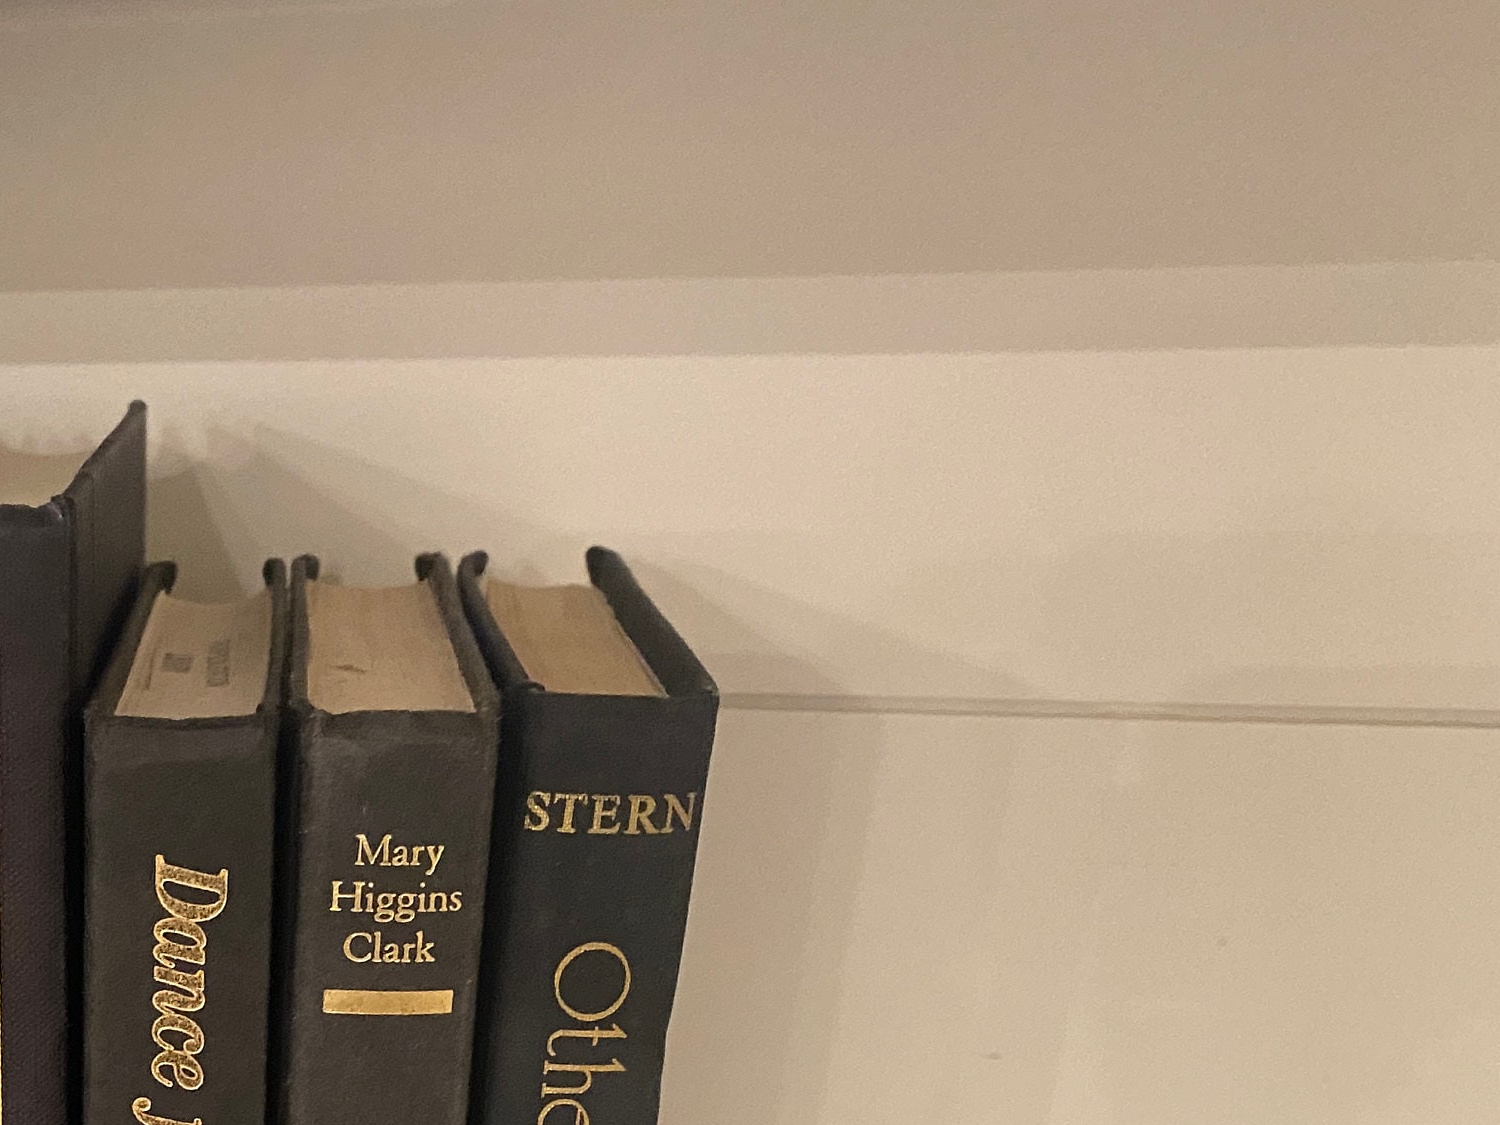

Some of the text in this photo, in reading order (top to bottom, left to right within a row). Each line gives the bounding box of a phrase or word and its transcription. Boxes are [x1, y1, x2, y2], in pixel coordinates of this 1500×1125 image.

[524, 791, 698, 835] STERN
[355, 834, 444, 875] Mary
[330, 881, 462, 922] Higgins
[343, 931, 435, 963] Clark
[151, 855, 228, 1090] Dance
